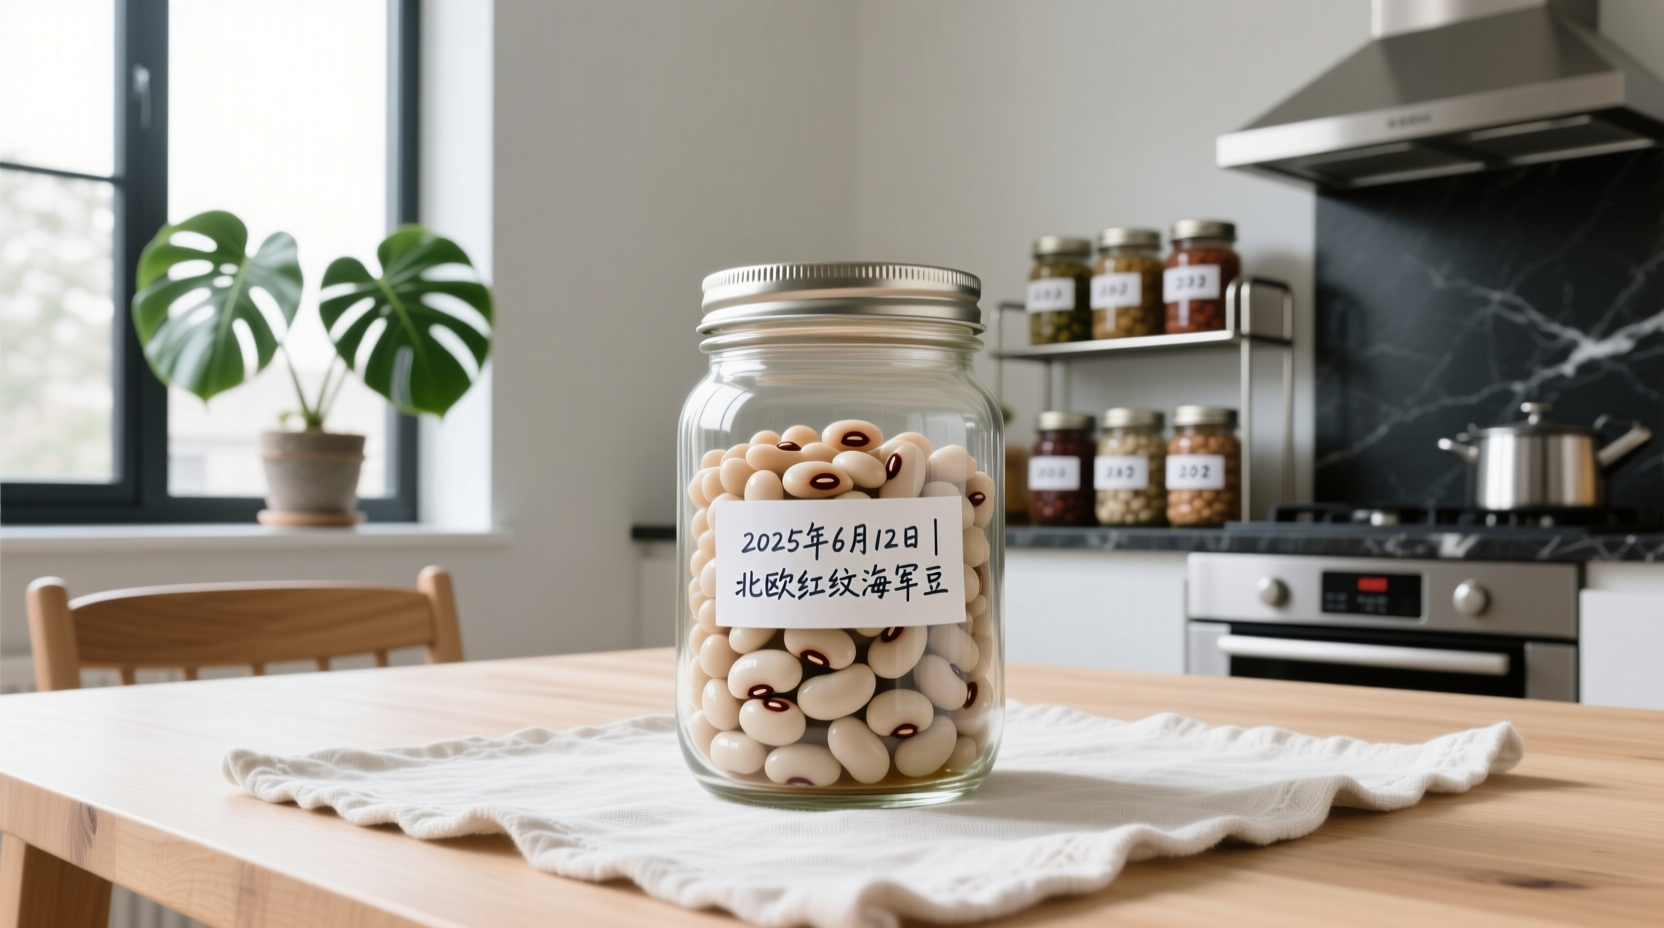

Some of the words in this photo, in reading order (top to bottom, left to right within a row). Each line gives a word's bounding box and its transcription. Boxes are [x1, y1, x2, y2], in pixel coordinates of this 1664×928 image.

[741, 522, 919, 560] 2025年6月12日
[735, 563, 949, 602] 北欧红纹海军豆
